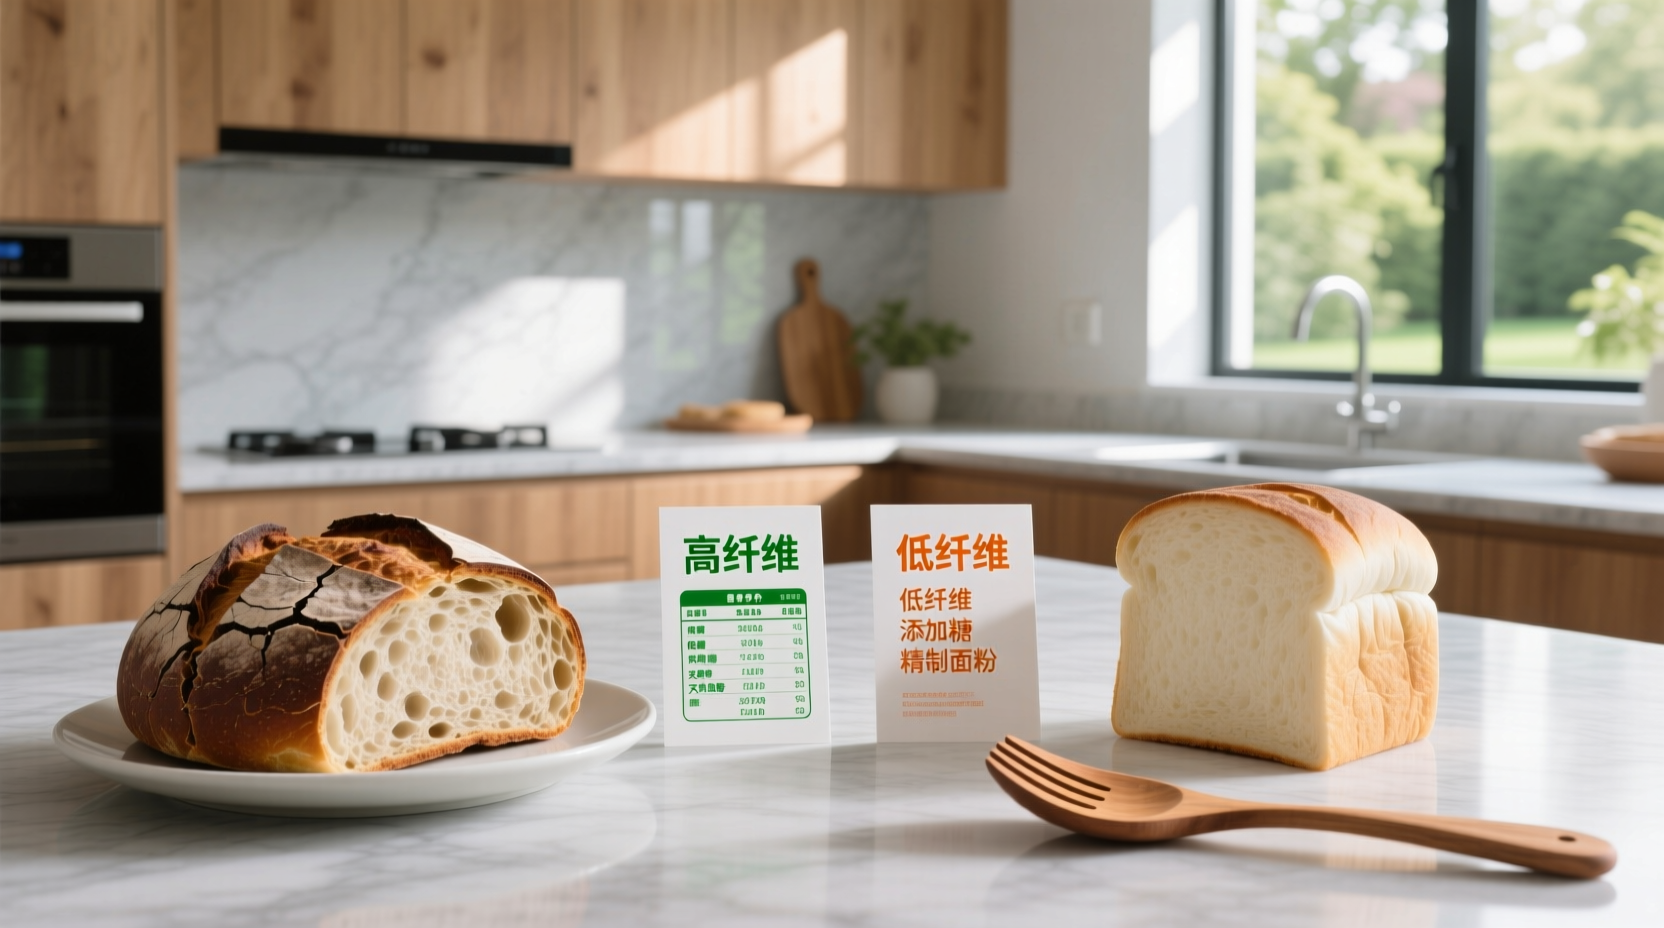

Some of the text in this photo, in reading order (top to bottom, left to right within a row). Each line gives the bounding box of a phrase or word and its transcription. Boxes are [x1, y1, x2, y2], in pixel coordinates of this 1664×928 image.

[683, 534, 799, 575] 高纤维
[896, 534, 1010, 572] 低纤维
[900, 588, 972, 612] 低纤维
[900, 617, 972, 642] 添加糖
[900, 648, 997, 673] 精制面粉
